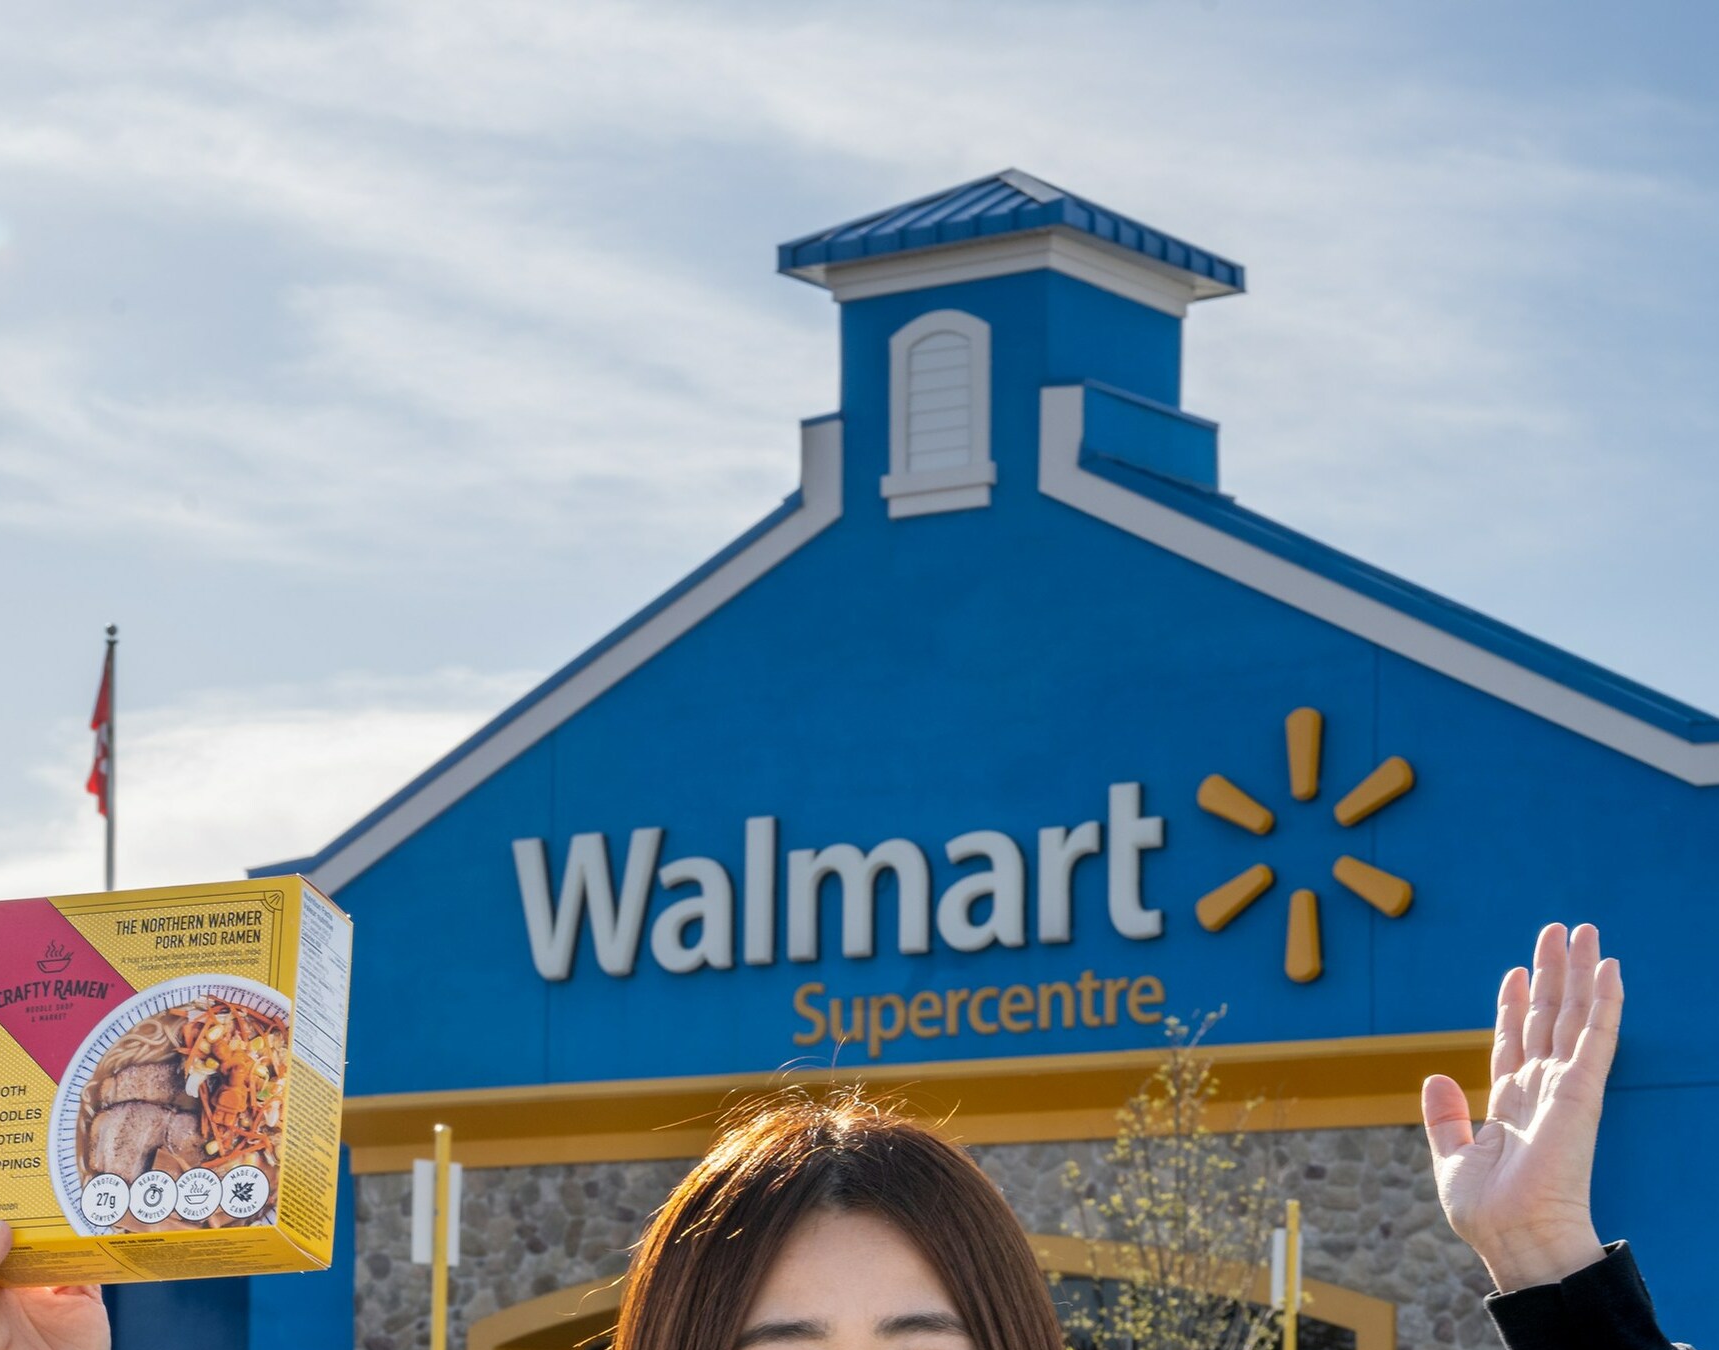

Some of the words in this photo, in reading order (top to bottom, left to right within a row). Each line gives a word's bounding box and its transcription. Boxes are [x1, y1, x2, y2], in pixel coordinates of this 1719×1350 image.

[511, 780, 1164, 982] Walmart
[116, 920, 137, 935] THE
[141, 914, 204, 934] NORTHERN
[208, 910, 262, 929] WARMER
[155, 934, 185, 949] PORK
[189, 931, 217, 947] MISO
[220, 929, 261, 945] RAMEN
[53, 979, 109, 1000] RAMEN
[25, 1004, 52, 1013] NOODLE
[56, 1002, 74, 1011] SHOP
[791, 969, 1165, 1058] Supercentre
[39, 1013, 67, 1021] MARKET
[138, 1174, 159, 1187] READY
[178, 1172, 217, 1189] RESTAURANT
[230, 1169, 249, 1180] MADE
[92, 1177, 120, 1188] PROTEIN
[96, 1192, 116, 1209] 27g
[91, 1211, 119, 1221] CONTENT
[137, 1207, 167, 1219] MINUTES!
[182, 1206, 210, 1216] QUALITY
